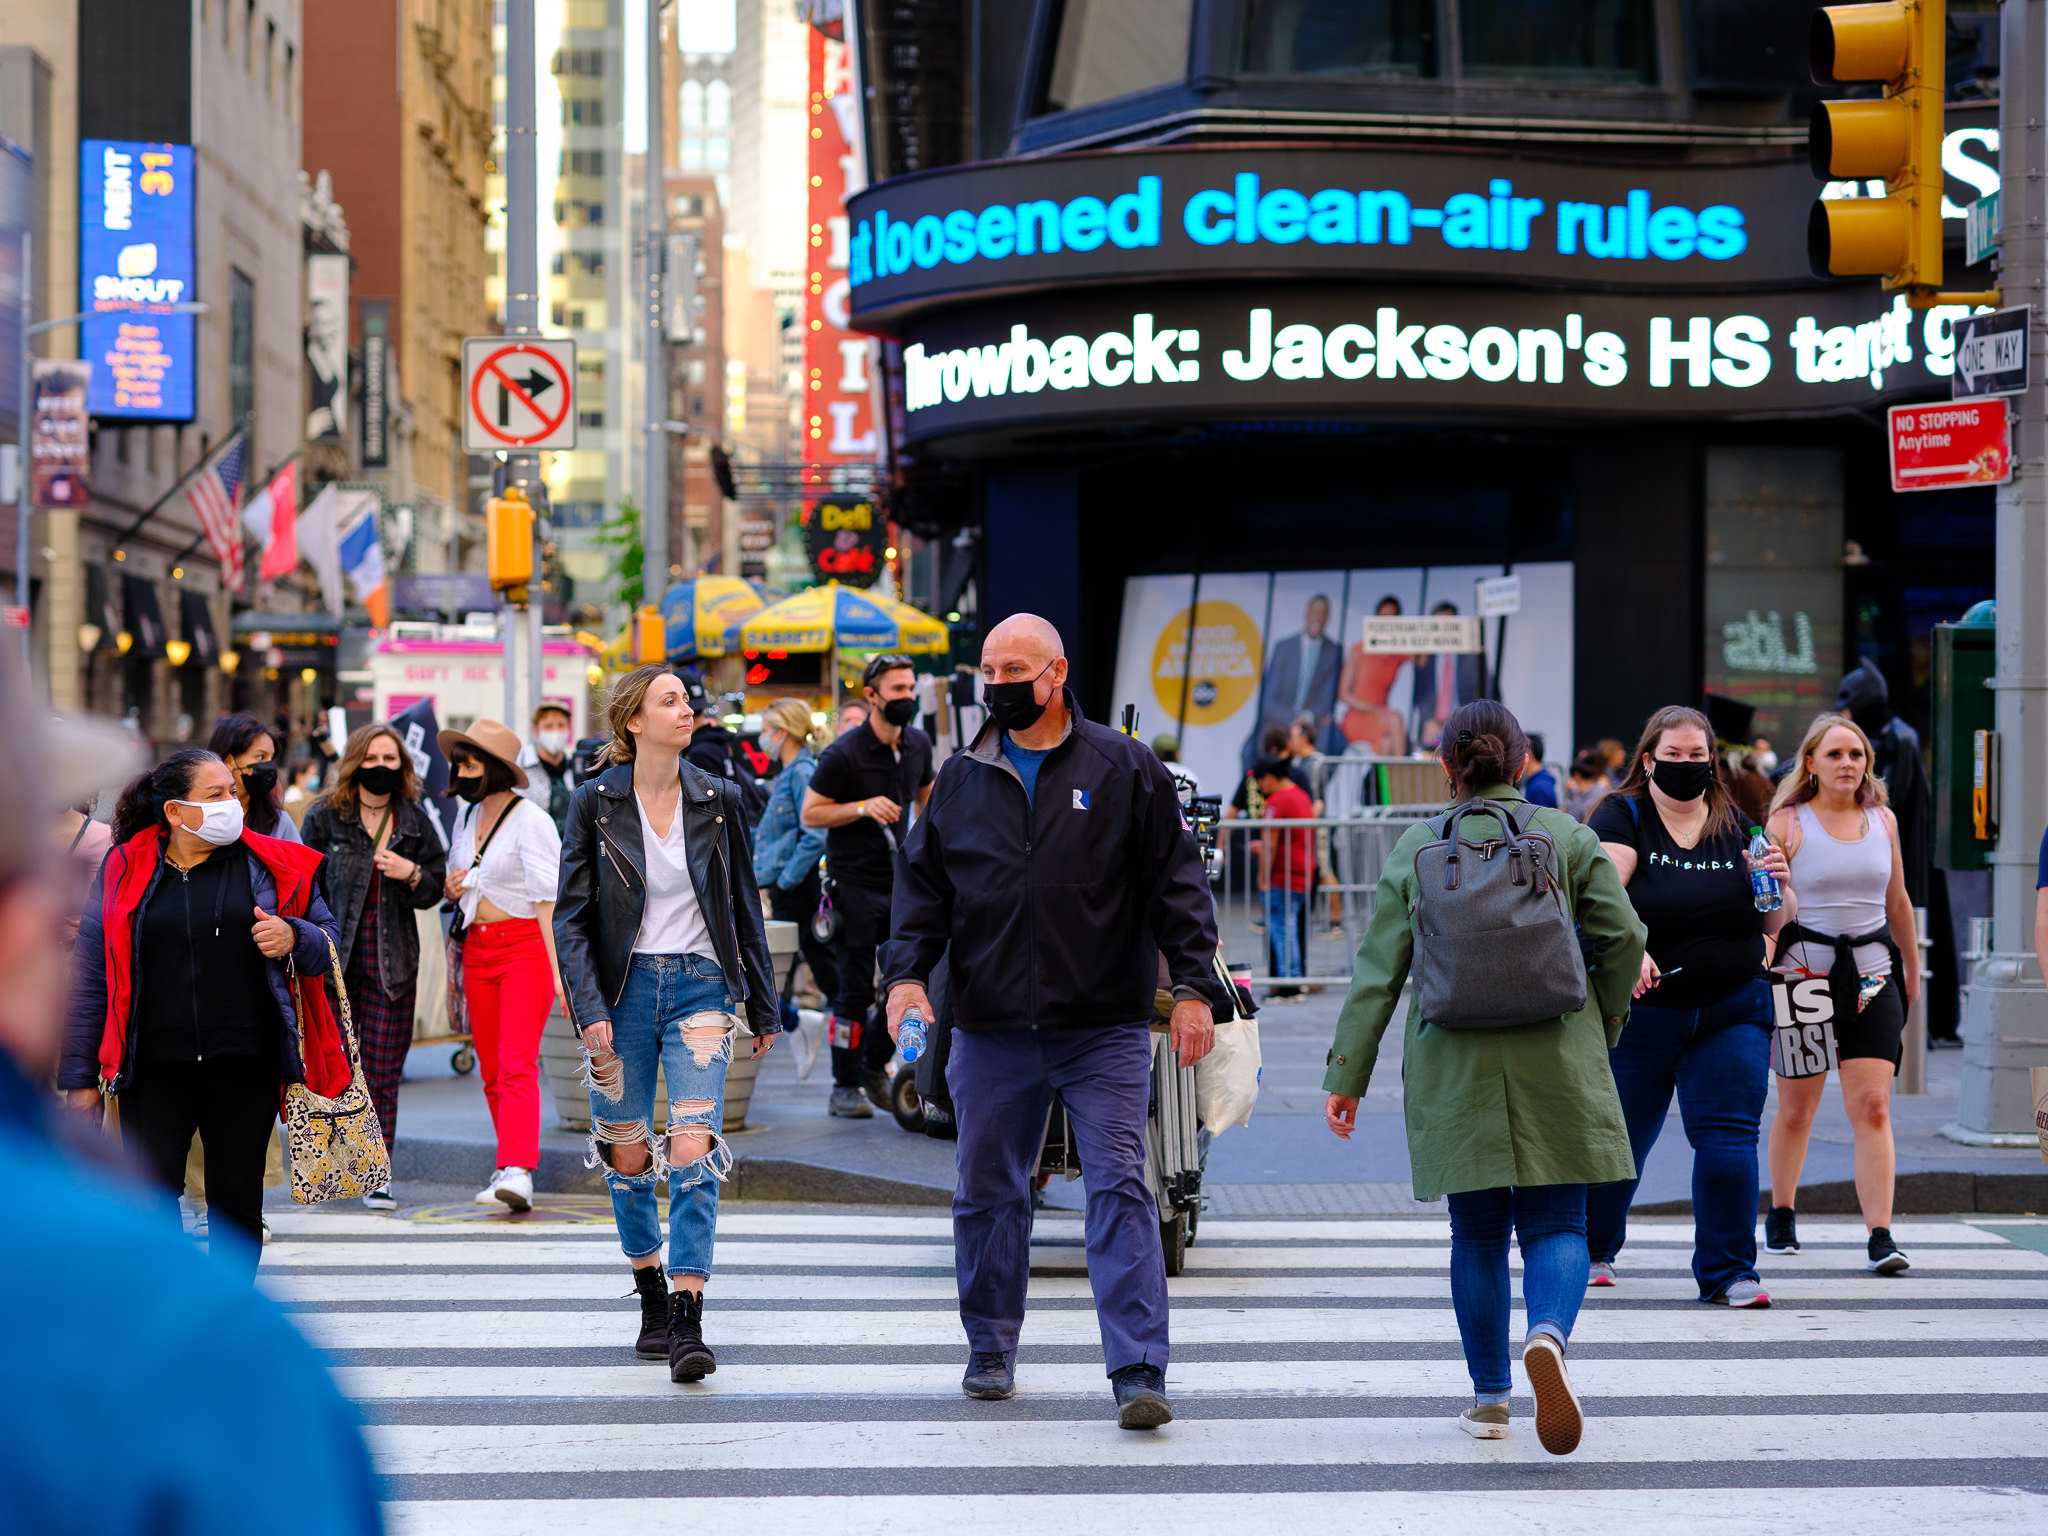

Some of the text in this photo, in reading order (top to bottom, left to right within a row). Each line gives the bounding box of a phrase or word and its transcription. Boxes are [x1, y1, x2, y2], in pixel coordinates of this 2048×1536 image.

[874, 175, 1162, 277] loosened
[1183, 172, 1545, 250] clean-air
[1557, 189, 1748, 260] rules
[94, 274, 184, 302] SHOUT
[1222, 308, 1628, 387] Jackson's
[1650, 315, 1771, 388] HS
[1965, 335, 2019, 373] ONE WAY
[1896, 409, 1980, 432] NO STOPPING
[1898, 432, 1951, 452] Anytime
[821, 503, 872, 531] Deli
[1772, 979, 1834, 1027] IS
